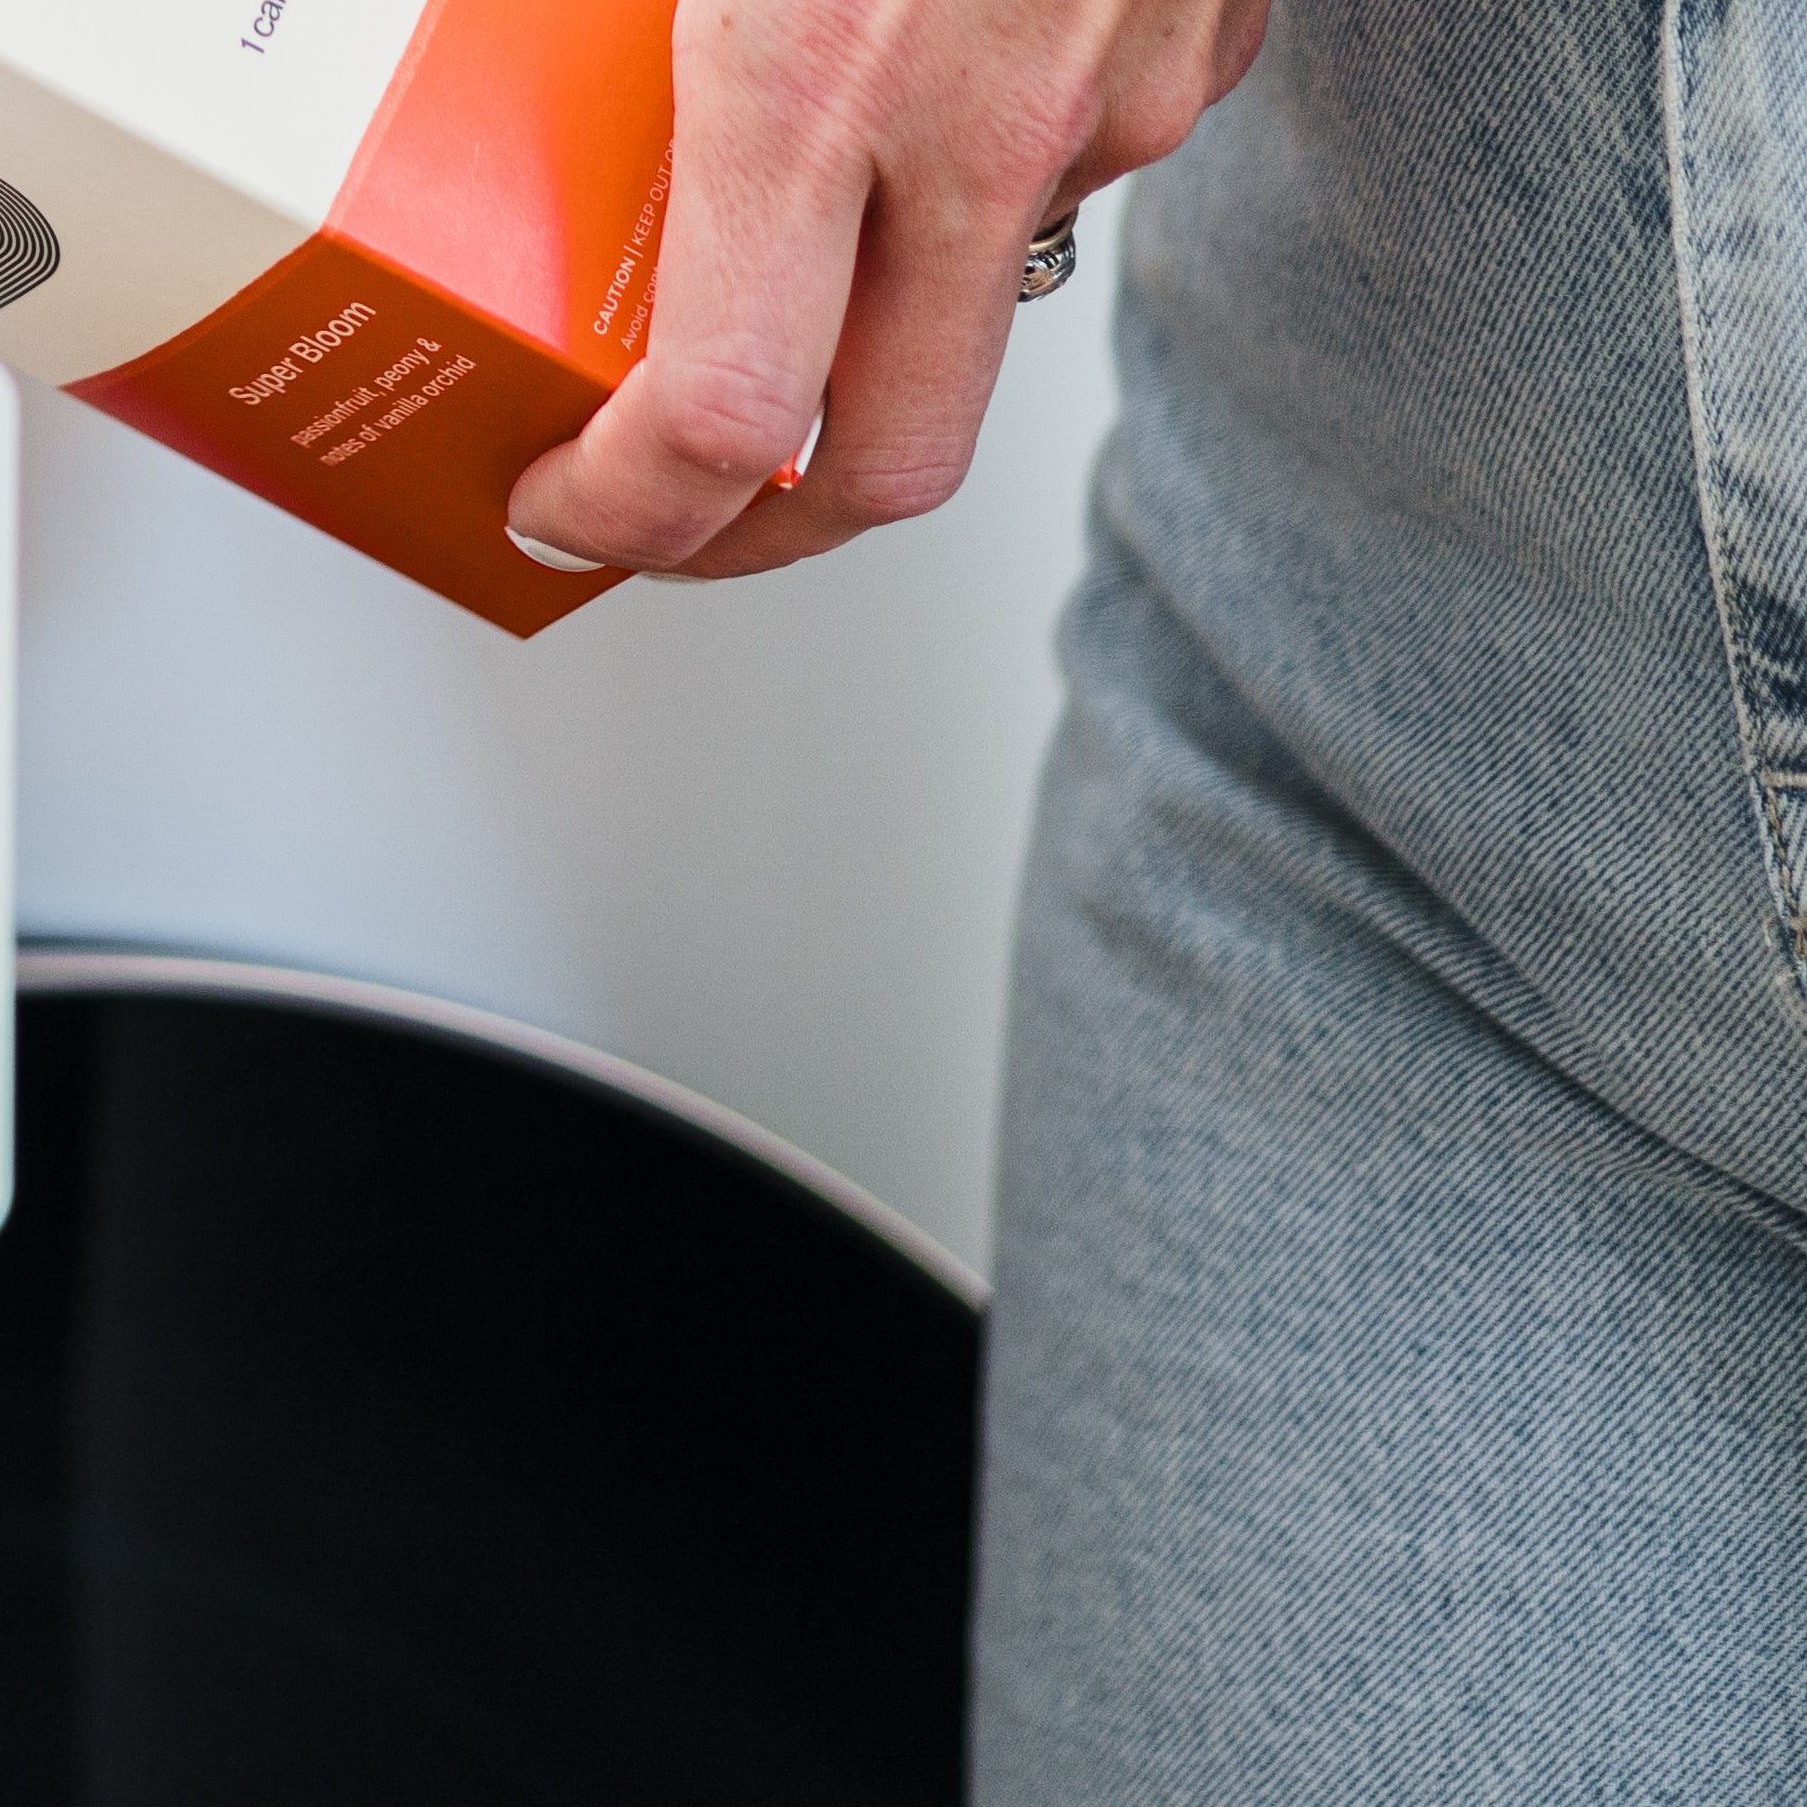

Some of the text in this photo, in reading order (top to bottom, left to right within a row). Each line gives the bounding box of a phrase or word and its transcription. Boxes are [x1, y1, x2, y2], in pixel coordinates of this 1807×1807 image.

[241, 38, 265, 54] 1
[593, 256, 636, 335] CAUTION
[631, 203, 656, 247] KEEP
[649, 165, 672, 202] OUT
[228, 301, 377, 406] Super Bloom
[620, 304, 648, 351] Avoid
[290, 337, 442, 448] passionfruit, peony &
[319, 354, 477, 466] notes of vanilla orchid
